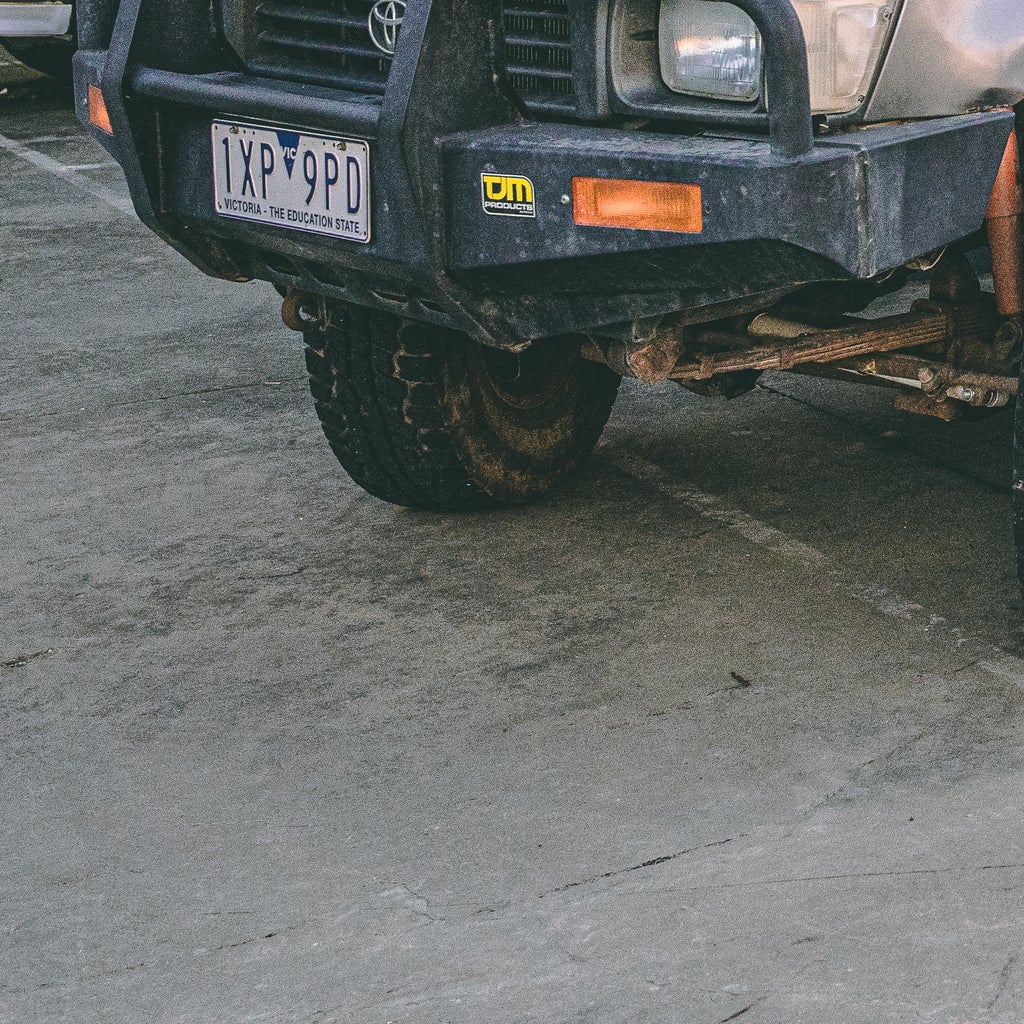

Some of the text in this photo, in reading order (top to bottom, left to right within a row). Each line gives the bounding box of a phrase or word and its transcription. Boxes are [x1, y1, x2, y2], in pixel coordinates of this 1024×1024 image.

[282, 146, 297, 160] VIC
[483, 175, 533, 203] TJM
[224, 198, 262, 215] VICTORIA
[269, 206, 285, 220] THE
[287, 210, 333, 228] EDUCATION
[335, 219, 360, 234] STATE
[484, 201, 533, 211] PRODUCTS
